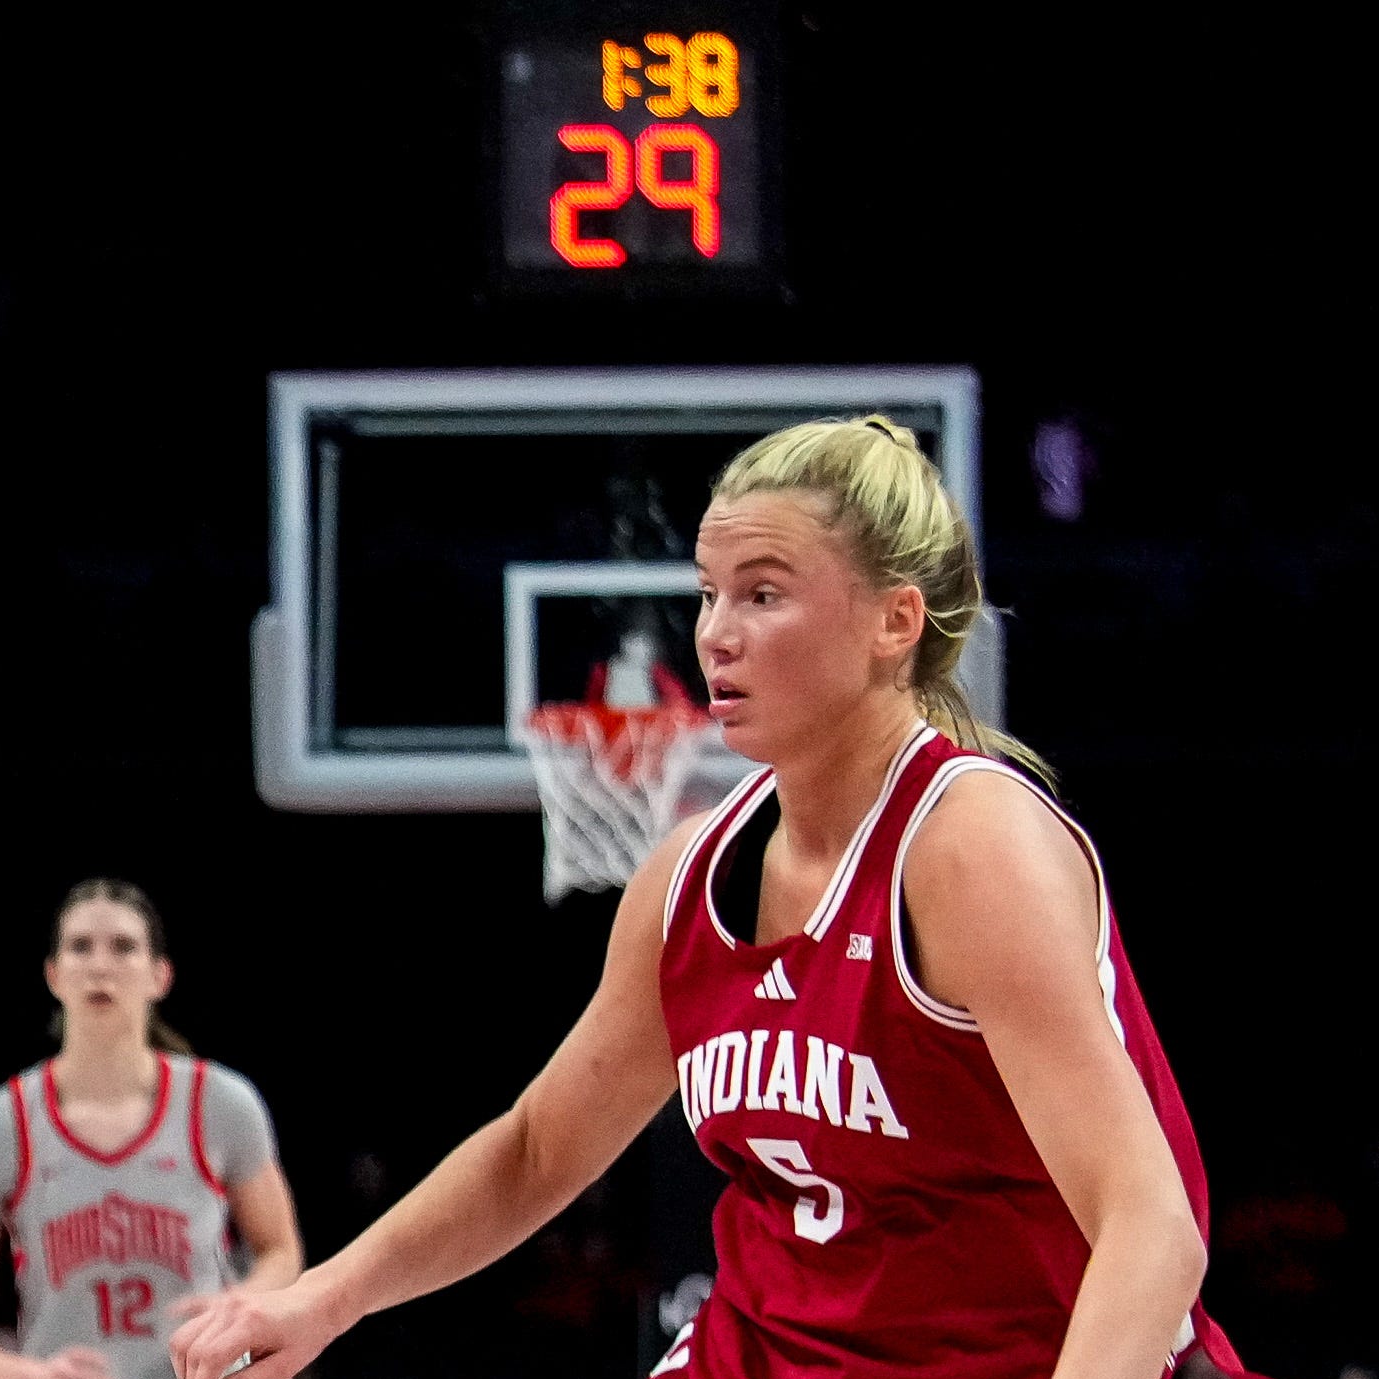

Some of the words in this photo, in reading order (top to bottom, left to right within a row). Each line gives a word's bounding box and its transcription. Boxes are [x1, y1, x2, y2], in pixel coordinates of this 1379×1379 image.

[602, 32, 740, 118] 1:38
[549, 123, 721, 268] 29
[677, 1029, 909, 1140] INDIANA
[746, 1137, 844, 1245] 5
[96, 1276, 156, 1338] 12
